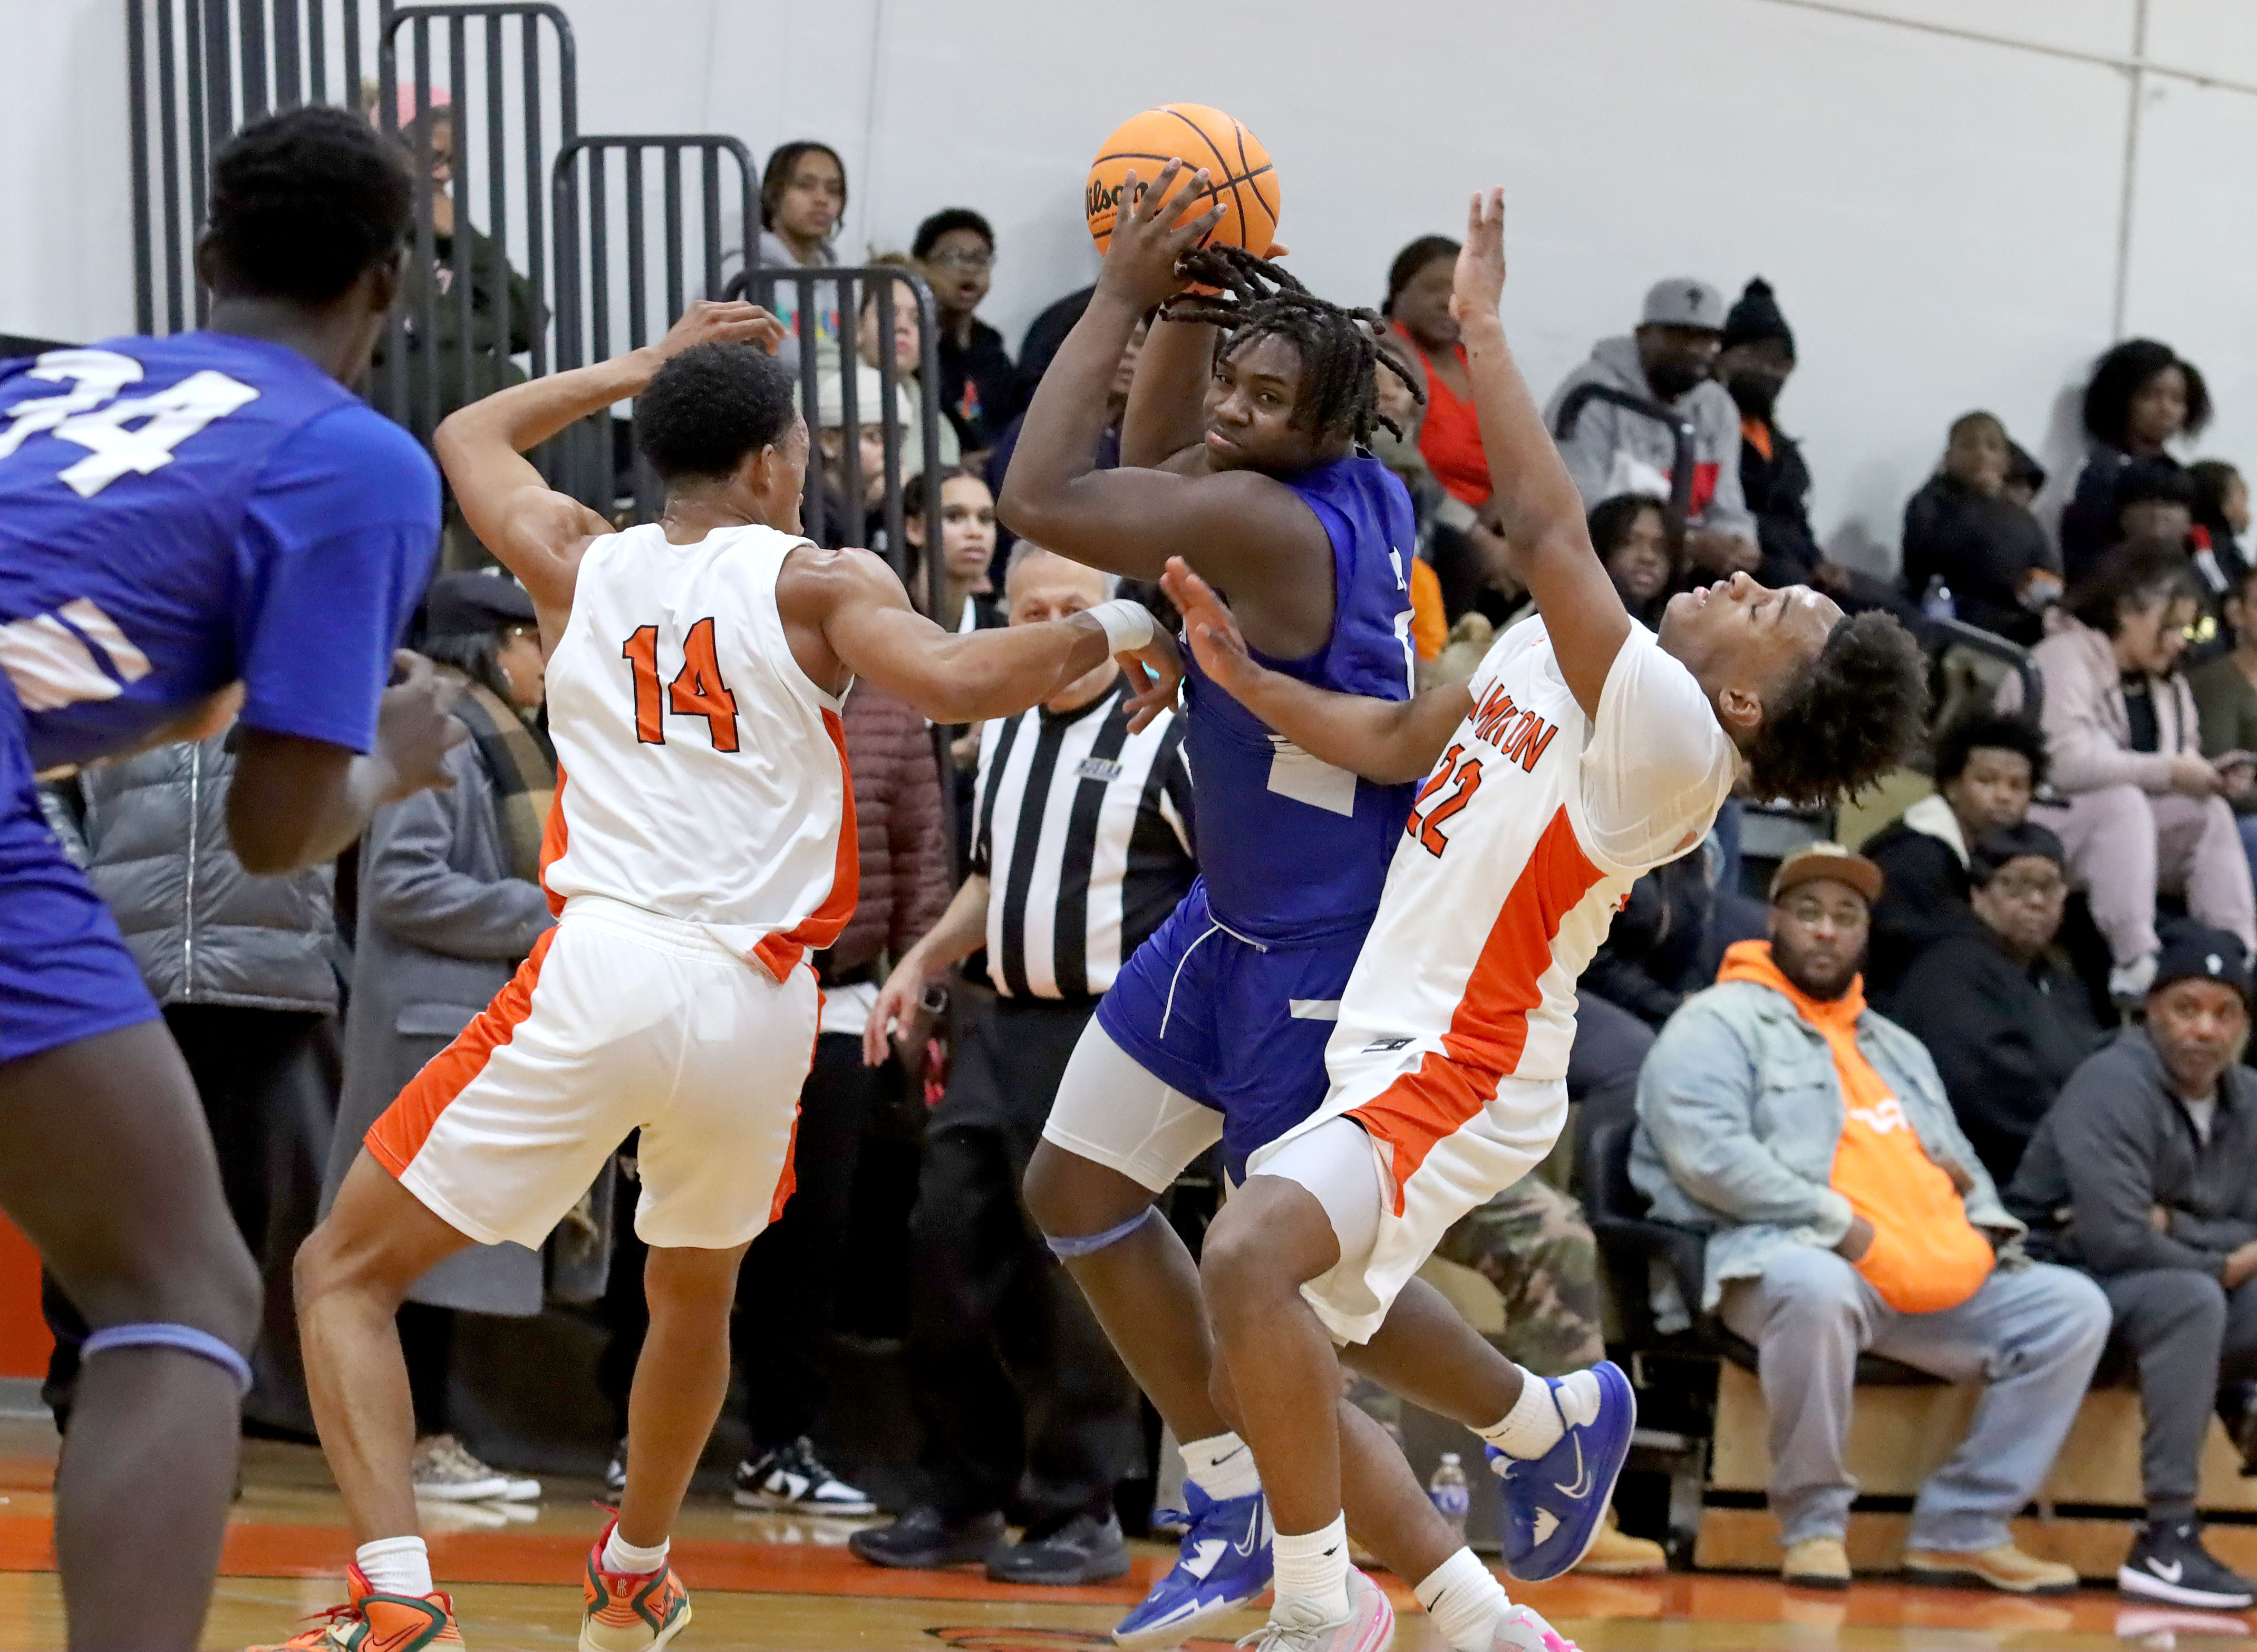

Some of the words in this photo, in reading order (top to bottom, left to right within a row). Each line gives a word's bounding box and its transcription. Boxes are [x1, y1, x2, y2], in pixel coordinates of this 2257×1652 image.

[1086, 179, 1148, 220] ilson
[622, 617, 740, 753] 14
[1407, 743, 1484, 859] 22
